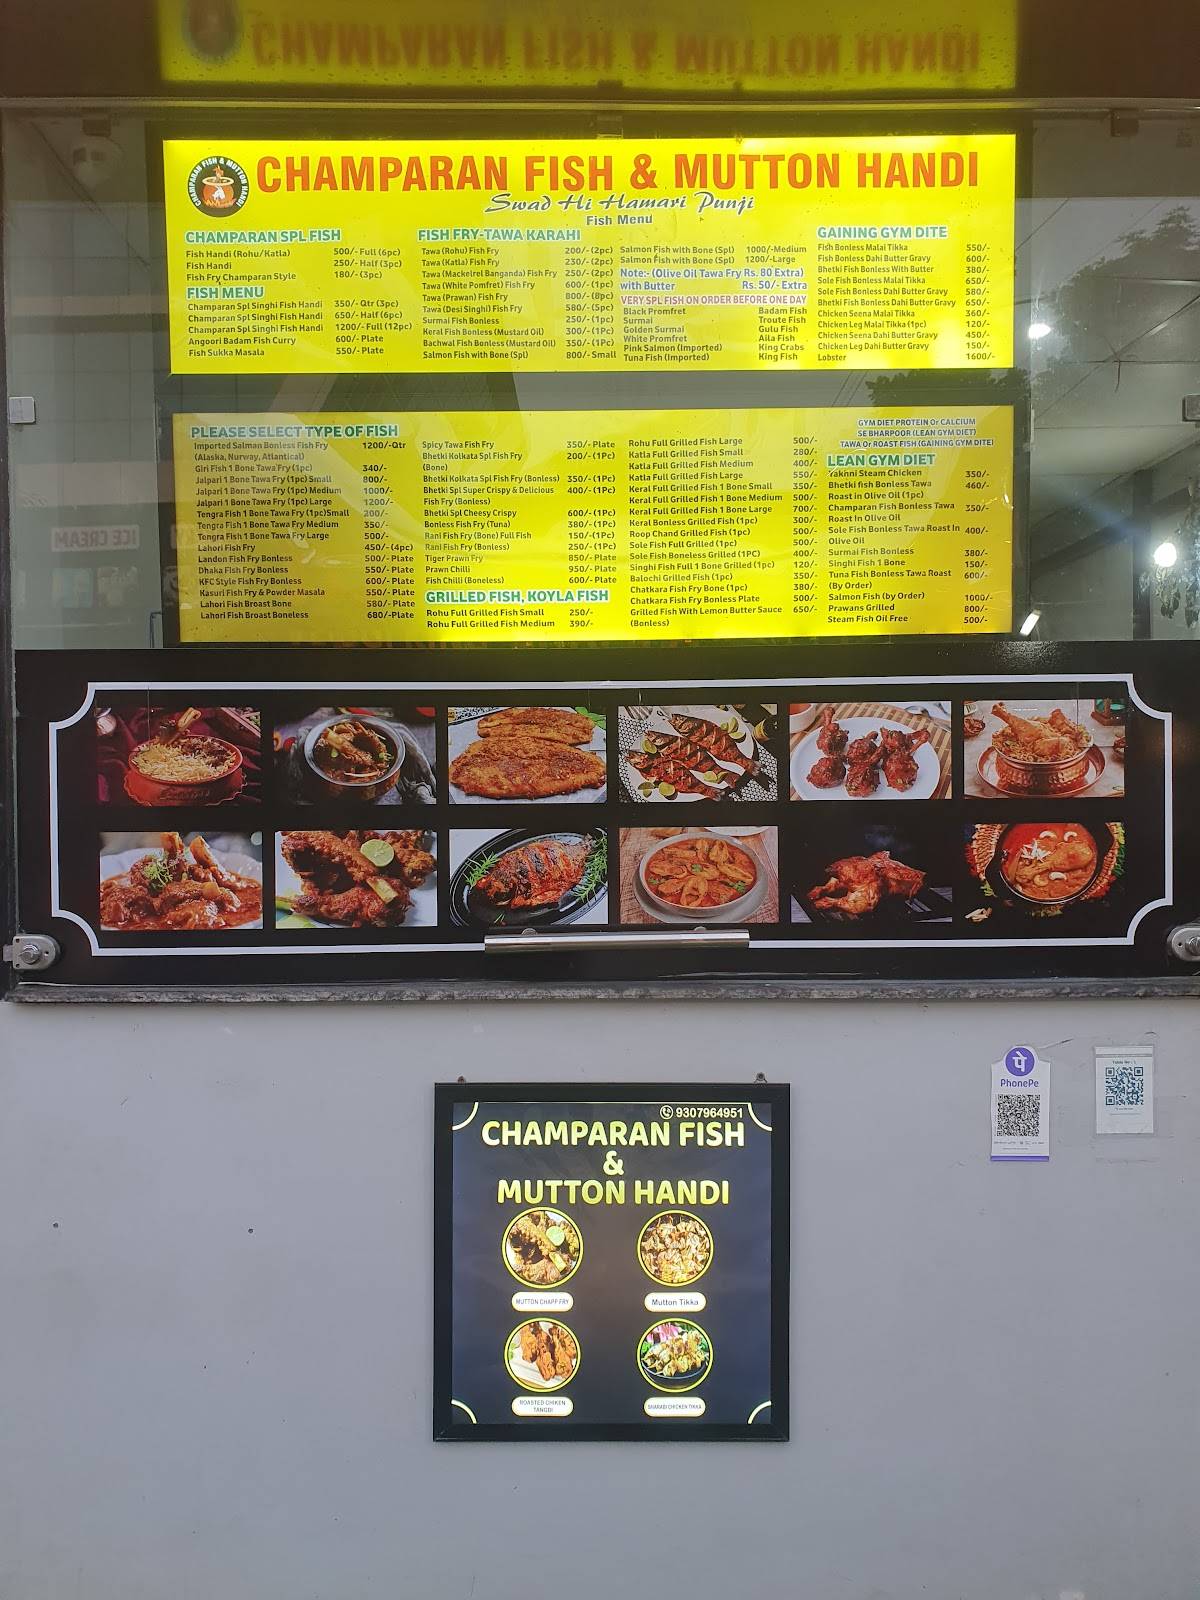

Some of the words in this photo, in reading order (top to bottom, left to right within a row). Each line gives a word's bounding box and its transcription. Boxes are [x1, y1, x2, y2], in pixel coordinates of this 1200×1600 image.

[201, 157, 218, 168] FISH
[225, 159, 248, 184] MUTTON
[256, 155, 508, 193] CHAMPARAN
[525, 155, 613, 191] FISH
[629, 153, 658, 190] &
[674, 153, 840, 190] MUTTON
[857, 151, 978, 188] HANDI
[188, 164, 203, 207] CHAMPARAN
[235, 185, 249, 207] HANDI
[484, 193, 552, 213] Swad
[557, 193, 592, 211] Hi
[598, 193, 687, 211] Hamari
[694, 191, 755, 215] Punji
[586, 215, 612, 226] Fish
[617, 214, 653, 225] Menu
[185, 231, 278, 243] CHAMPARAN
[280, 230, 306, 243] SPL
[309, 229, 341, 242] FISH
[418, 230, 449, 241] FISH
[453, 229, 523, 241] FRY-TAWA
[526, 229, 580, 241] KARAHI
[817, 227, 877, 239] GAINING
[880, 227, 912, 238] GYM
[915, 226, 947, 238] DITE
[186, 250, 205, 258] Fish
[206, 250, 232, 258] Handi
[233, 249, 291, 259] (Rohu/Katla)
[333, 247, 358, 256] 500/-
[359, 248, 377, 256] Full
[378, 248, 401, 258] (6pc)
[422, 247, 441, 255] Tawa
[441, 247, 468, 255] (Rohu)
[486, 247, 499, 256] Fry
[565, 247, 589, 255] 200/-
[591, 247, 613, 255] (2pc)
[620, 269, 650, 278] Note:-
[652, 269, 682, 279] (Olive
[684, 269, 697, 278] Oil
[700, 269, 724, 278] Tawa
[725, 269, 741, 279] Fry
[744, 269, 759, 277] Rs.
[760, 269, 773, 277] 80
[774, 268, 804, 278] Extra)
[620, 281, 642, 291] with
[644, 282, 675, 291] Butter
[742, 281, 757, 290] Rs.
[759, 281, 780, 290] 50/-
[781, 281, 807, 290] Extra
[187, 287, 219, 299] FISH
[222, 286, 264, 298] MENU
[334, 299, 359, 308] 350/-
[360, 299, 375, 308] Qtr
[376, 299, 399, 309] (3pc)
[621, 295, 645, 305] VERY
[646, 295, 663, 305] SPL
[664, 295, 684, 305] FISH
[686, 295, 699, 305] ON
[701, 295, 732, 304] ORDER
[733, 295, 767, 304] BEFORE
[769, 295, 788, 304] ONE
[790, 295, 807, 304] DAY
[187, 302, 236, 312] Champaran
[236, 301, 251, 312] Spl
[251, 301, 278, 311] Singhi
[279, 300, 297, 309] Fish
[298, 300, 323, 309] Handi
[818, 331, 848, 339] Chicken
[849, 331, 872, 339] Seena
[873, 331, 890, 339] Dahi
[891, 331, 915, 339] Butter
[916, 331, 938, 340] Gravy
[966, 331, 990, 339] 450/-
[423, 351, 453, 359] Salmon
[454, 351, 469, 359] Fish
[470, 351, 488, 359] with
[489, 351, 509, 359] Bone
[510, 351, 528, 359] (Spl)
[566, 351, 591, 359] 800/-
[858, 419, 876, 427] GYM
[877, 419, 894, 427] DIET
[895, 419, 929, 427] PROTEIN
[930, 419, 939, 427] Or
[940, 418, 975, 426] CALCIUM
[191, 427, 246, 438] PLEASE
[248, 426, 303, 437] SELECT
[305, 426, 342, 437] TYPE
[344, 426, 363, 437] OF
[366, 425, 398, 437] FISH
[827, 454, 865, 467] LEAN
[869, 454, 900, 466] GYM
[903, 454, 935, 465] DIET
[629, 519, 651, 527] Keral
[687, 518, 717, 526] Grilled
[717, 517, 735, 525] Fish
[736, 517, 758, 526] (1pc)
[793, 516, 817, 524] 300/-
[198, 532, 224, 542] Tengra
[225, 532, 242, 540] Fish
[244, 532, 248, 540] 1
[250, 532, 269, 540] Bone
[292, 532, 306, 541] Fry
[307, 532, 330, 541] Large
[364, 532, 389, 540] 500/-
[426, 591, 486, 603] GRILLED
[489, 591, 524, 604] FISH,
[528, 590, 575, 602] KOYLA
[578, 590, 609, 601] FISH
[200, 611, 226, 619] Lahori
[227, 611, 244, 619] Fish
[245, 611, 271, 619] Broast
[272, 611, 309, 619] Boneless
[426, 609, 449, 617] Rohu
[451, 609, 468, 617] Full
[469, 609, 499, 617] Grilled
[569, 608, 593, 616] 250/-
[1000, 1078, 1039, 1088] PhonePe
[675, 1107, 744, 1119] 9307964951
[482, 1121, 670, 1147] CHAMPARAN
[679, 1121, 745, 1147] FISH
[603, 1150, 625, 1176] &
[497, 1179, 625, 1205] MUTTON
[635, 1180, 729, 1205] HANDI
